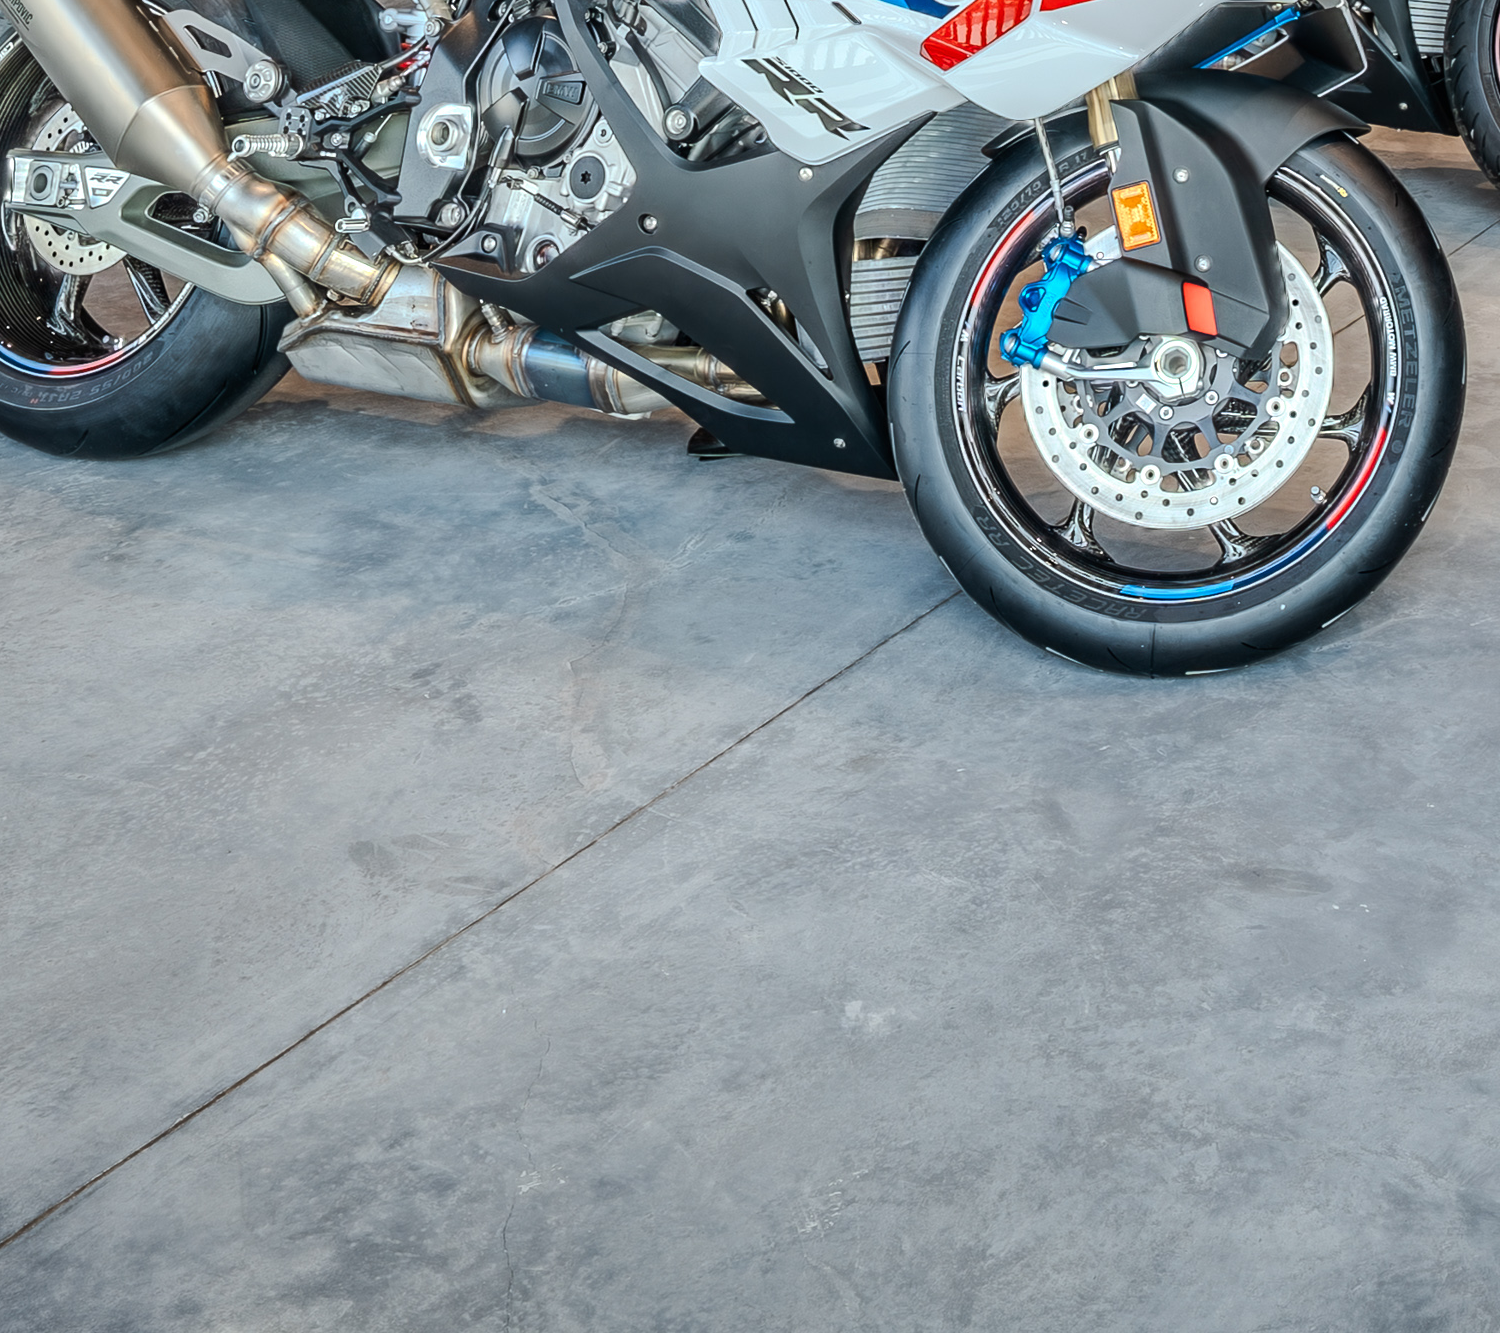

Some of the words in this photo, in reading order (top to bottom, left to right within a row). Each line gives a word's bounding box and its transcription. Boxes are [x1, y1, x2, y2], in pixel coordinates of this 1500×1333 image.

[545, 80, 581, 103] BMW
[740, 57, 872, 142] RR
[771, 55, 825, 94] S1000
[1379, 296, 1397, 351] MOTORRAD
[955, 355, 967, 412] Carbon
[1389, 352, 1398, 377] BMW
[1394, 283, 1419, 429] METZELER
[975, 515, 1011, 548] RR
[1010, 555, 1147, 621] RACETEC
